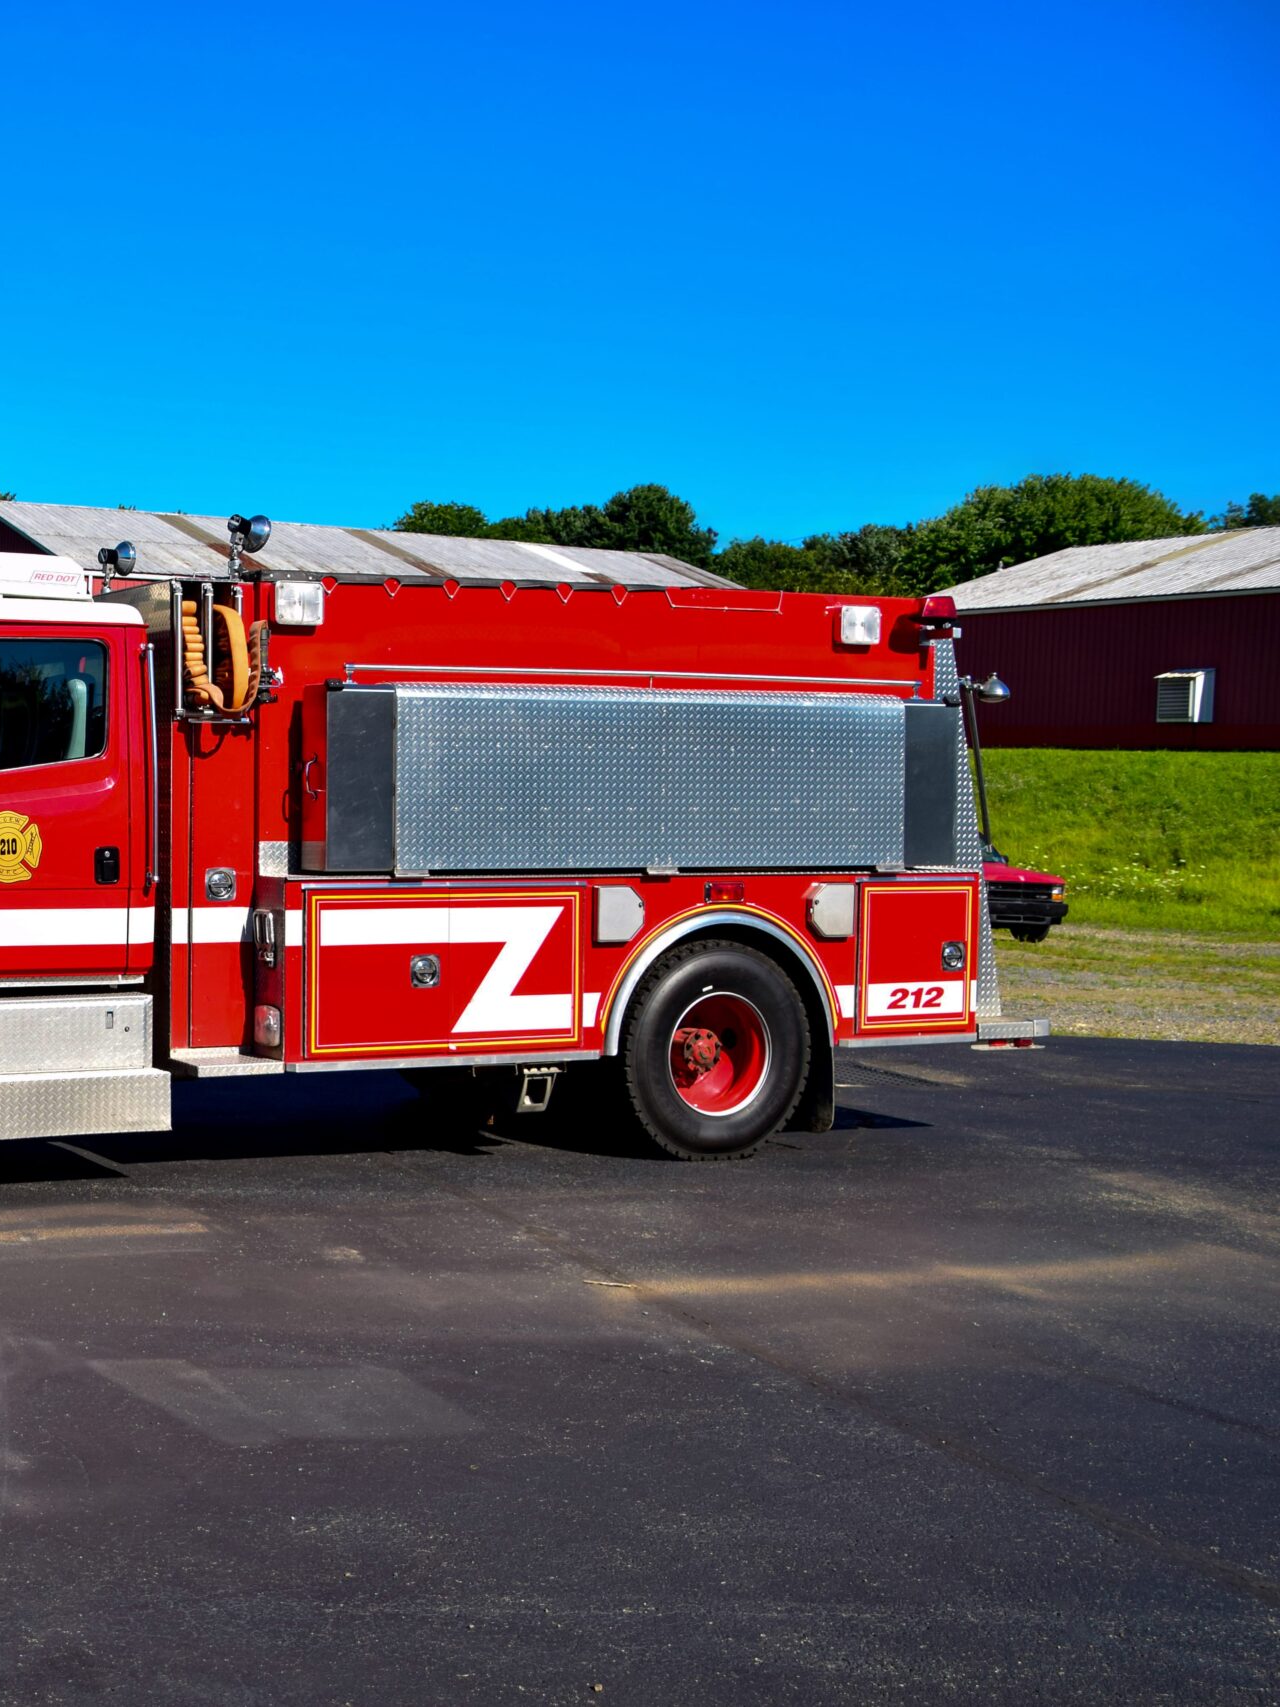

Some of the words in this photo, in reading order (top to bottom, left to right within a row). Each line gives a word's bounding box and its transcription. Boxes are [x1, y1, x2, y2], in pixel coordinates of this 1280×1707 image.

[34, 573, 54, 581] RED
[55, 575, 76, 583] DOT
[0, 837, 18, 856] 210
[886, 986, 945, 1010] 212
